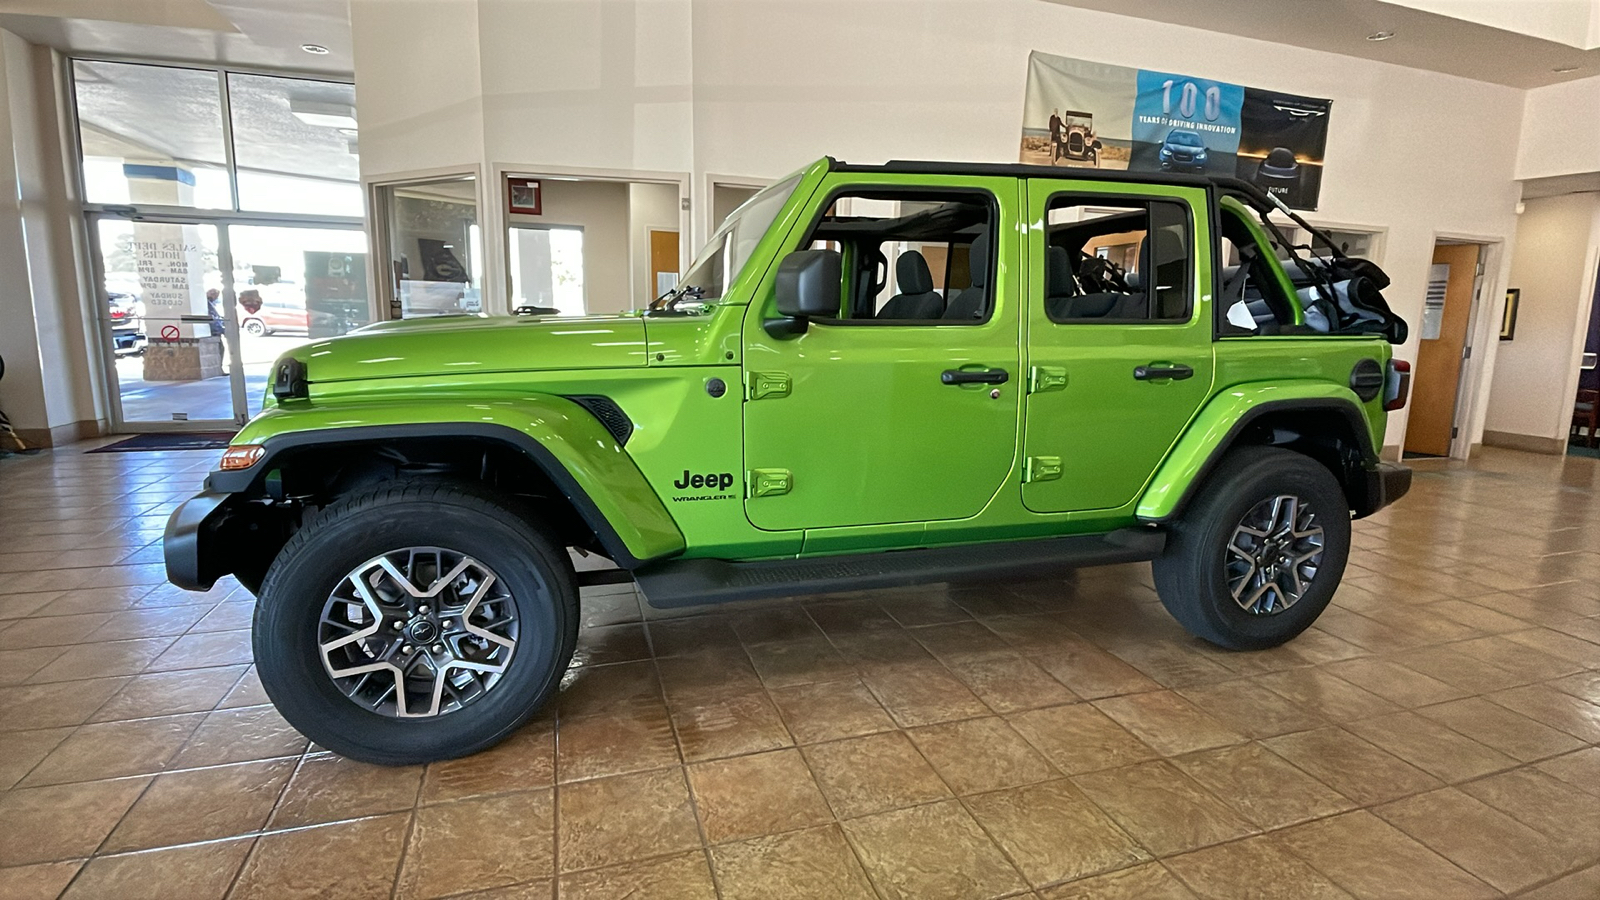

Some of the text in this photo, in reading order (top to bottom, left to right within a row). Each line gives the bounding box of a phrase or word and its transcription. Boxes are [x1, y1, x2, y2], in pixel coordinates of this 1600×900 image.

[1162, 80, 1221, 121] 100
[1139, 115, 1161, 124] YEARS
[1168, 119, 1195, 129] DRIVING
[1196, 122, 1236, 134] INNOVATION
[1268, 186, 1289, 194] FUTURE
[673, 470, 734, 491] Jeep
